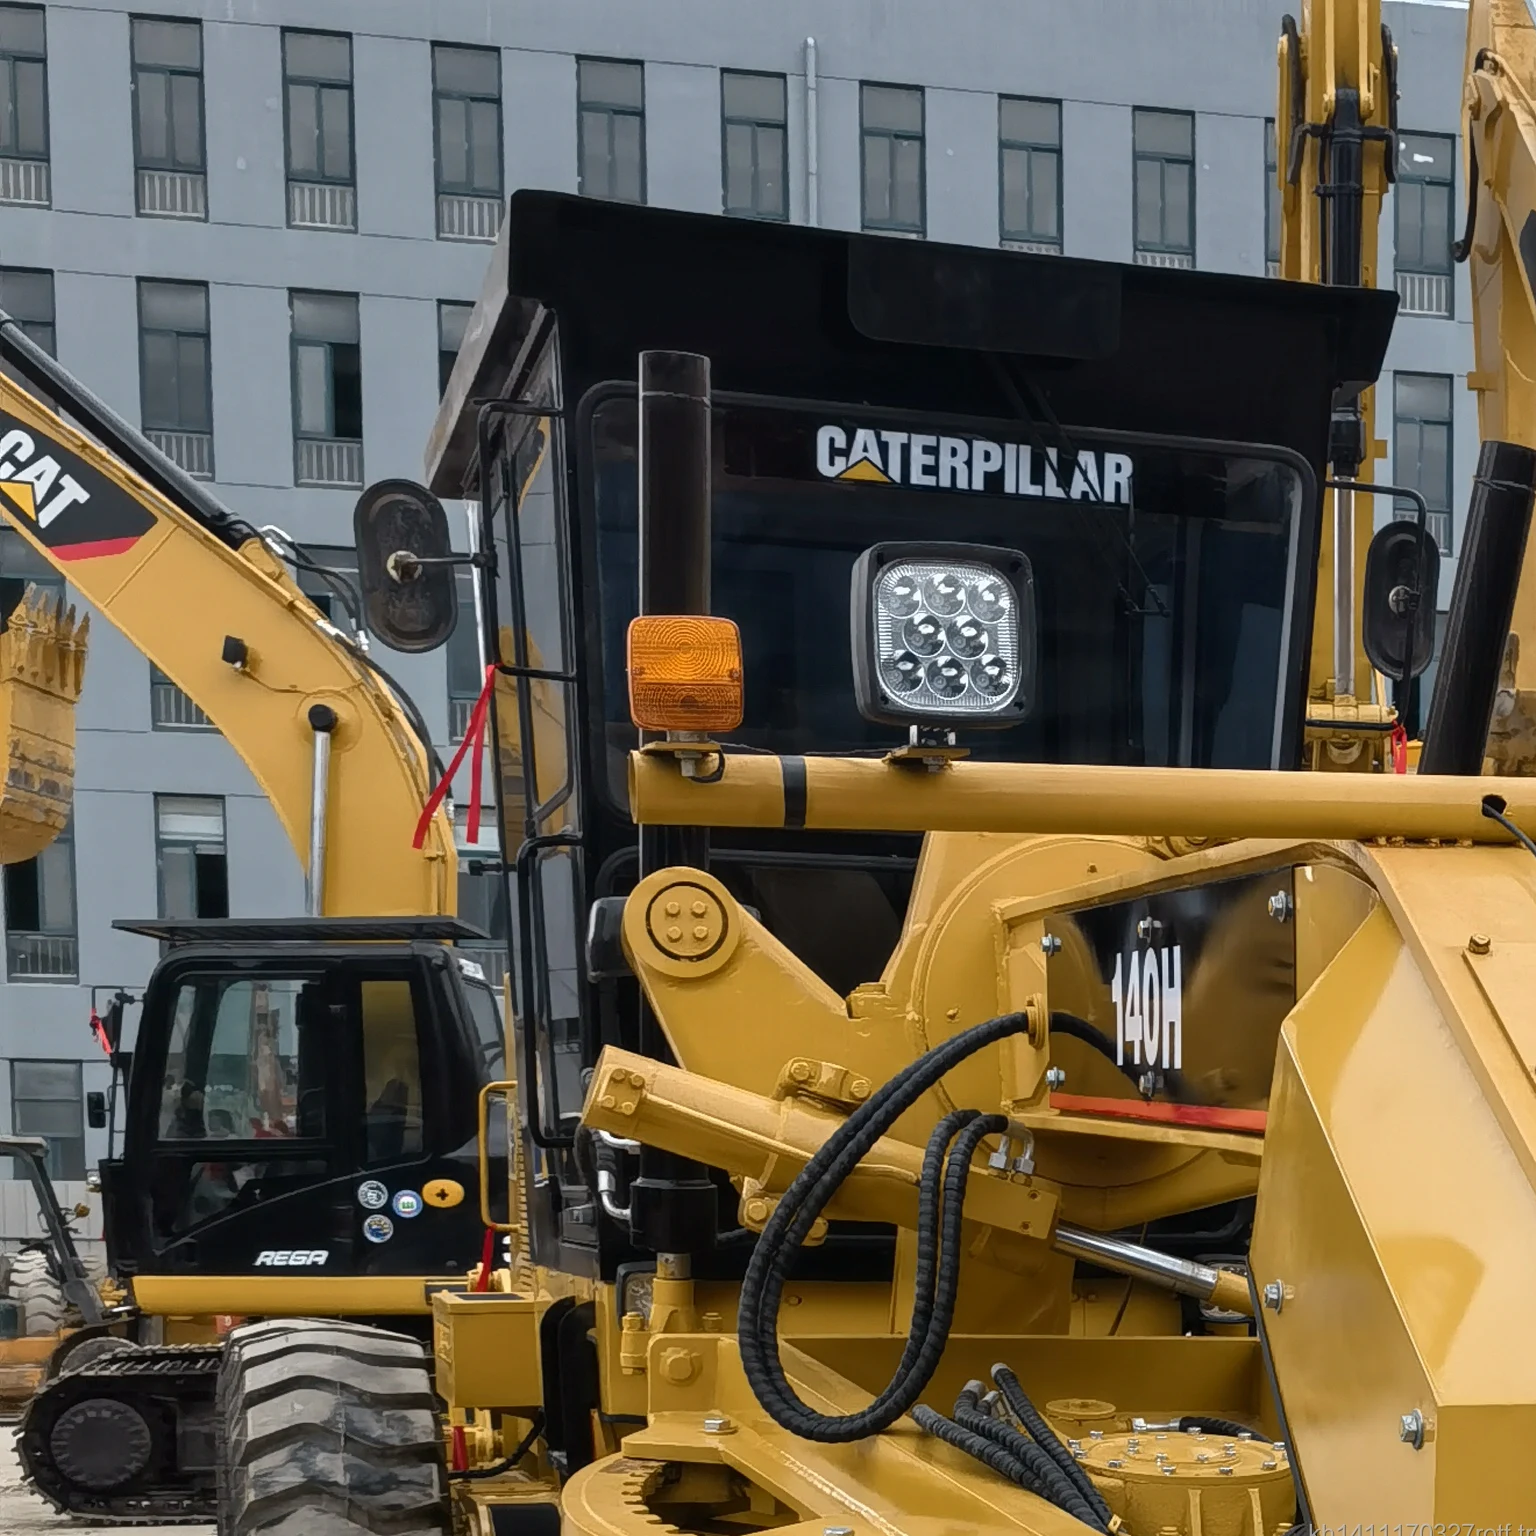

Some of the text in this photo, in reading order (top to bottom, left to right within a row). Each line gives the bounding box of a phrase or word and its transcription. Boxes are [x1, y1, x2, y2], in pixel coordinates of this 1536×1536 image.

[816, 424, 1134, 504] CATERPILLAR
[1111, 945, 1182, 1070] 140H
[252, 1249, 329, 1267] REGA
